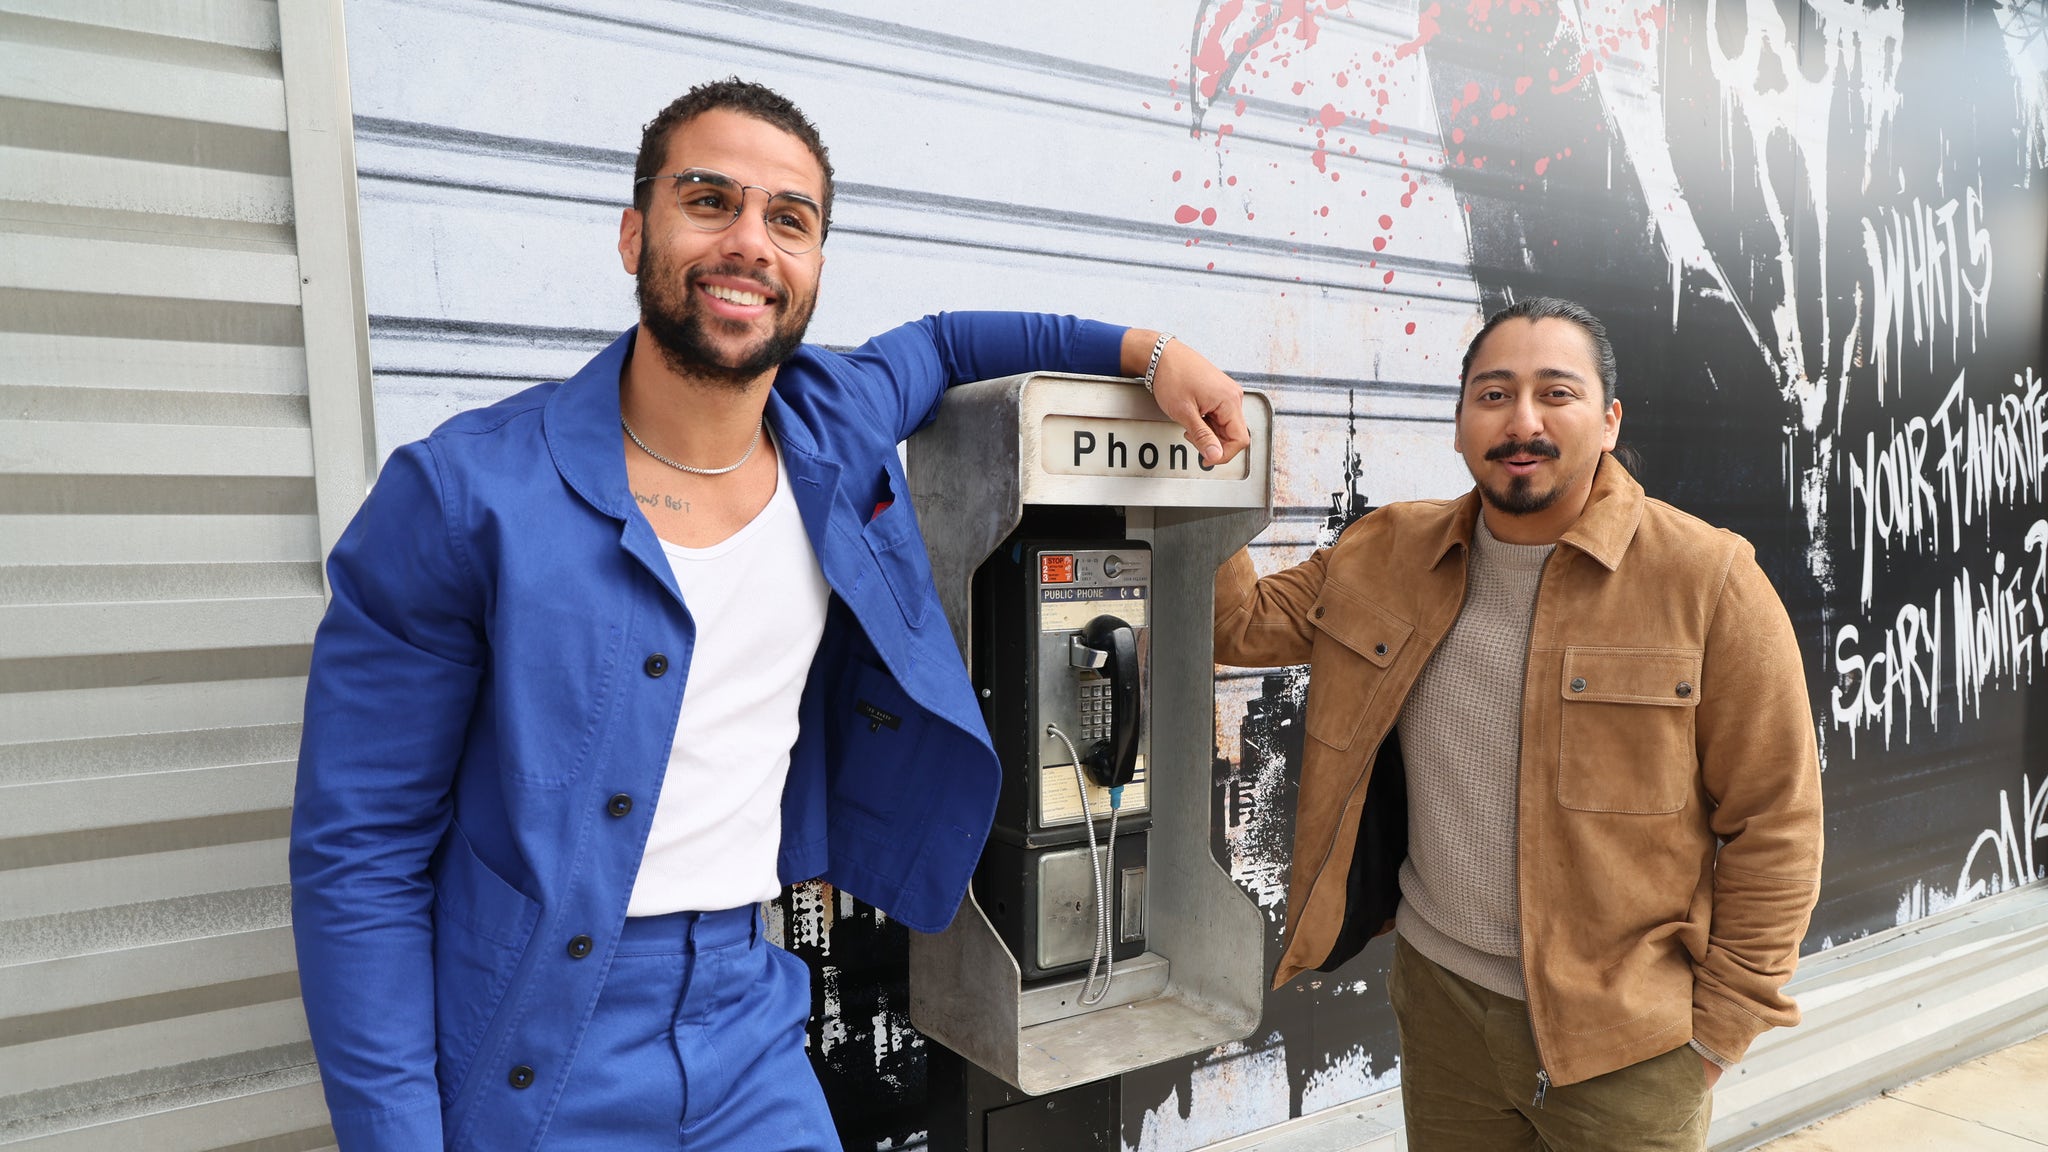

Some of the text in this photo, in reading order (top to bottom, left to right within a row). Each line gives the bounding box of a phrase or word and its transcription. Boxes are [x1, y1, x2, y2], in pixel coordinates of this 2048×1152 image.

[1850, 416, 1939, 606] YOUR
[1042, 565, 1048, 573] 2
[1042, 573, 1048, 582] 3
[1044, 588, 1104, 599] PUBLIC PHONE
[1832, 588, 1942, 755] SCARY
